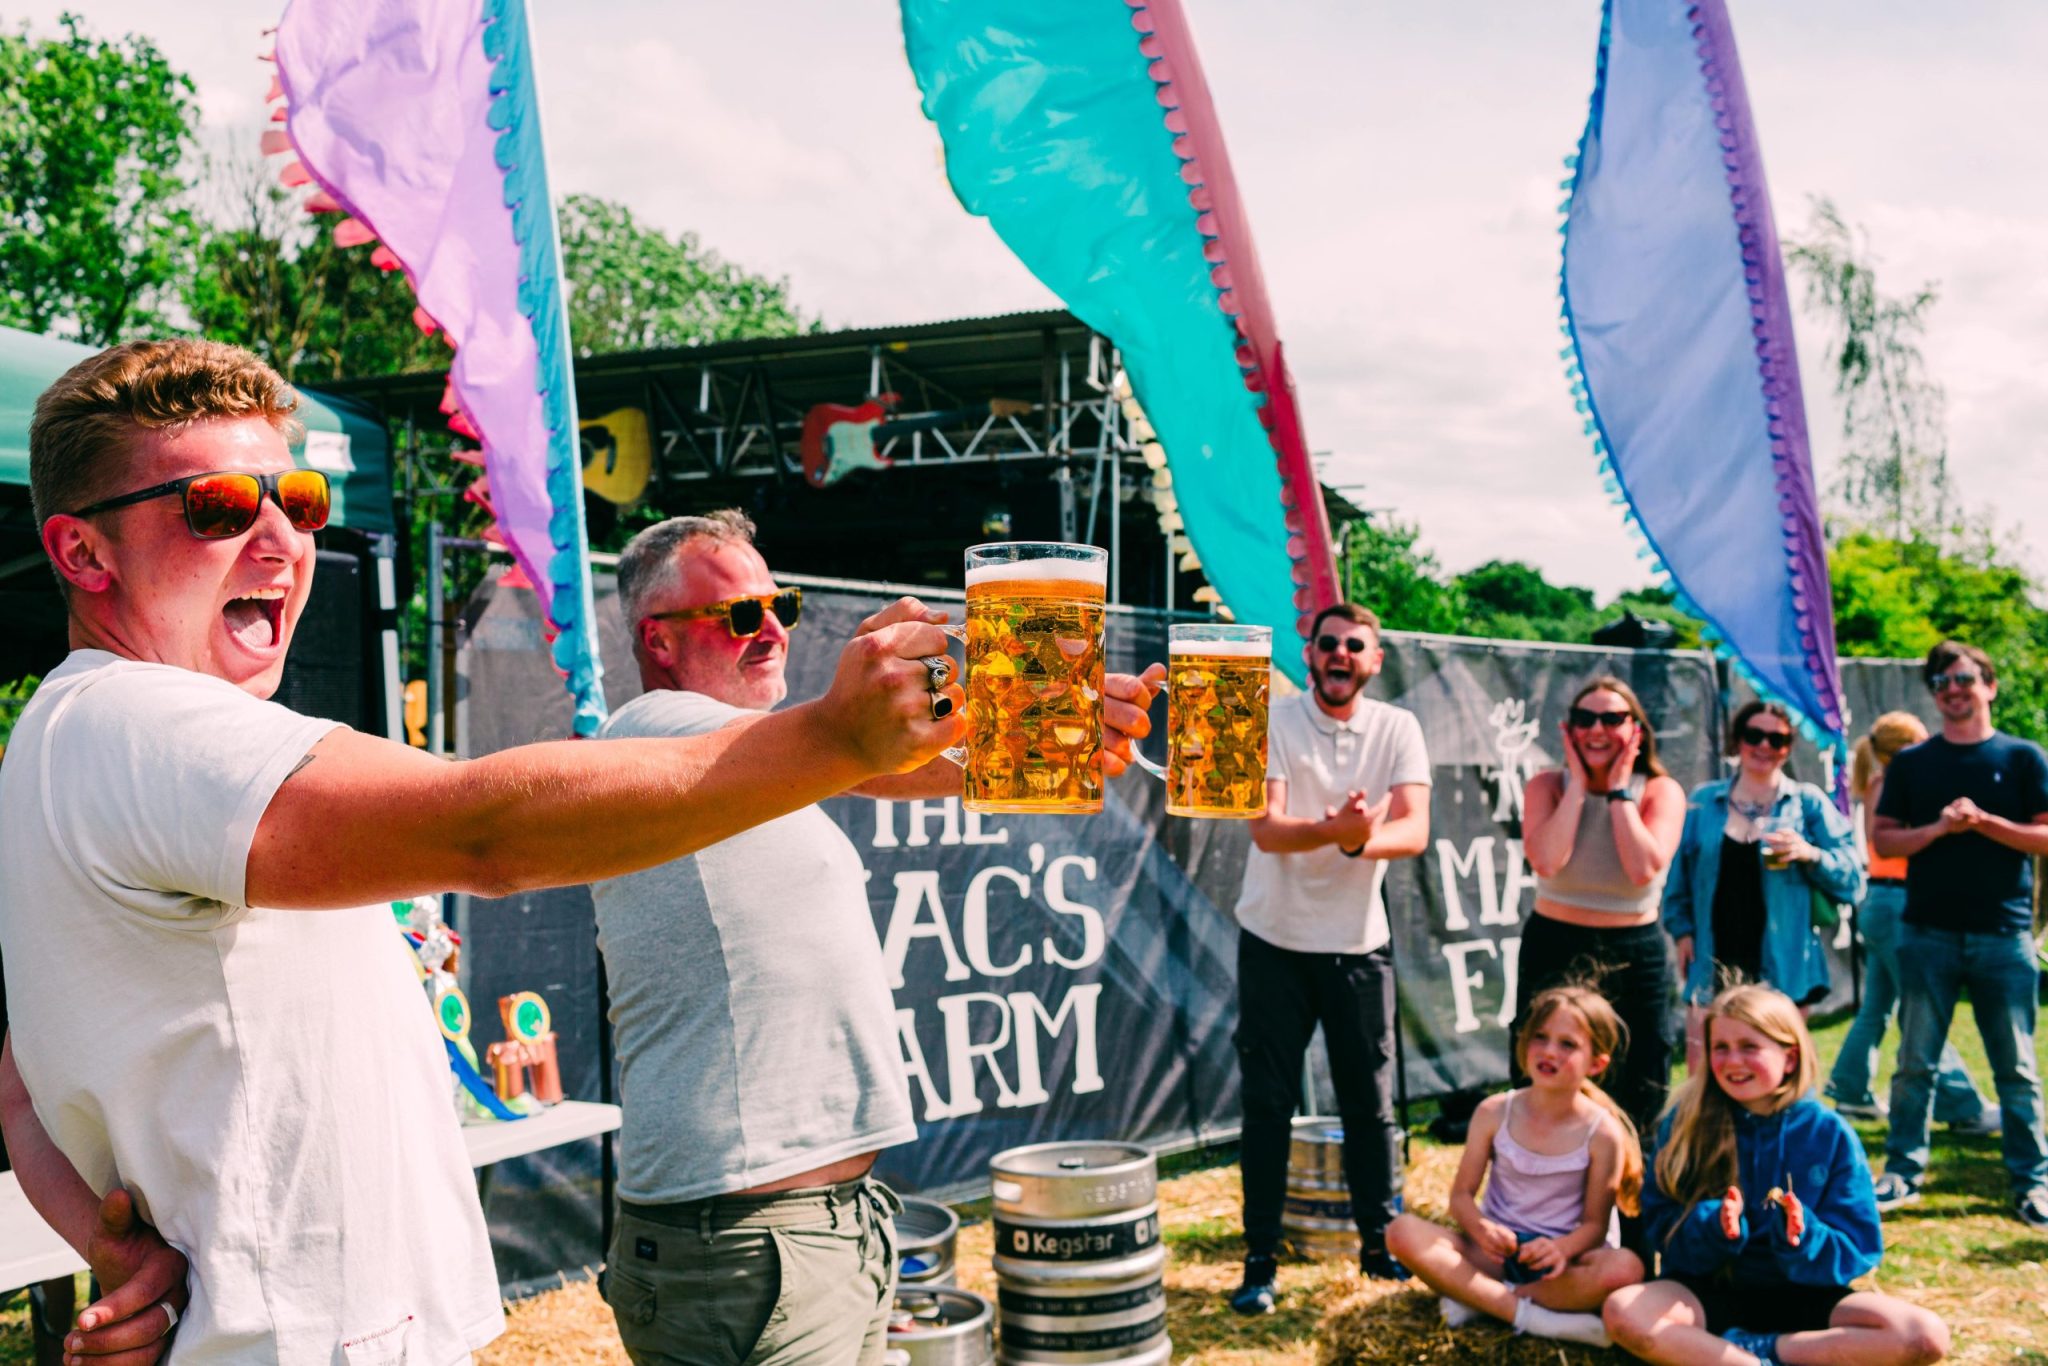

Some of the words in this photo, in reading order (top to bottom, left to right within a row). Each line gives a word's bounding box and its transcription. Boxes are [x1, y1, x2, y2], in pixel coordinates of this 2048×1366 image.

[864, 842, 1106, 990] AC'S
[895, 983, 1104, 1122] ARM
[1033, 1231, 1115, 1259] Kegstar
